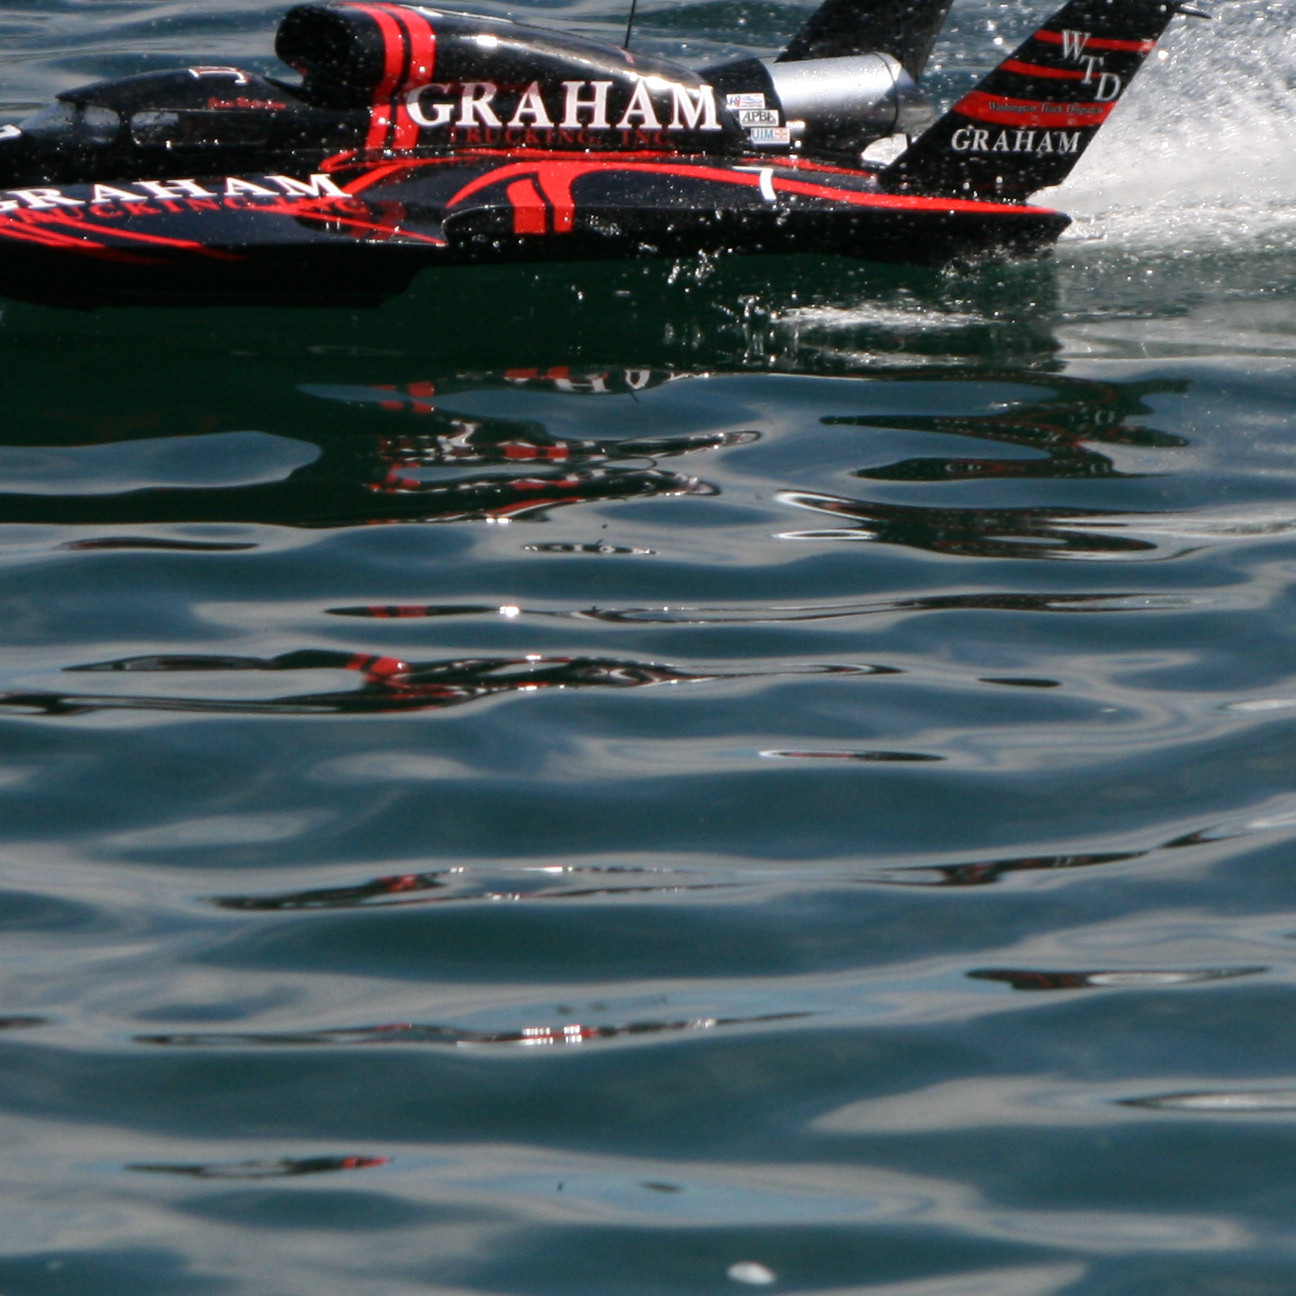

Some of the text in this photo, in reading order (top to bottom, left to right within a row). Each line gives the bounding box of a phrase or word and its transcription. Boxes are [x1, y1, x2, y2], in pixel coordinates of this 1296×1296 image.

[406, 80, 722, 130] GRAHAM
[742, 110, 777, 122] APBA
[951, 128, 1081, 153] GRAHAM
